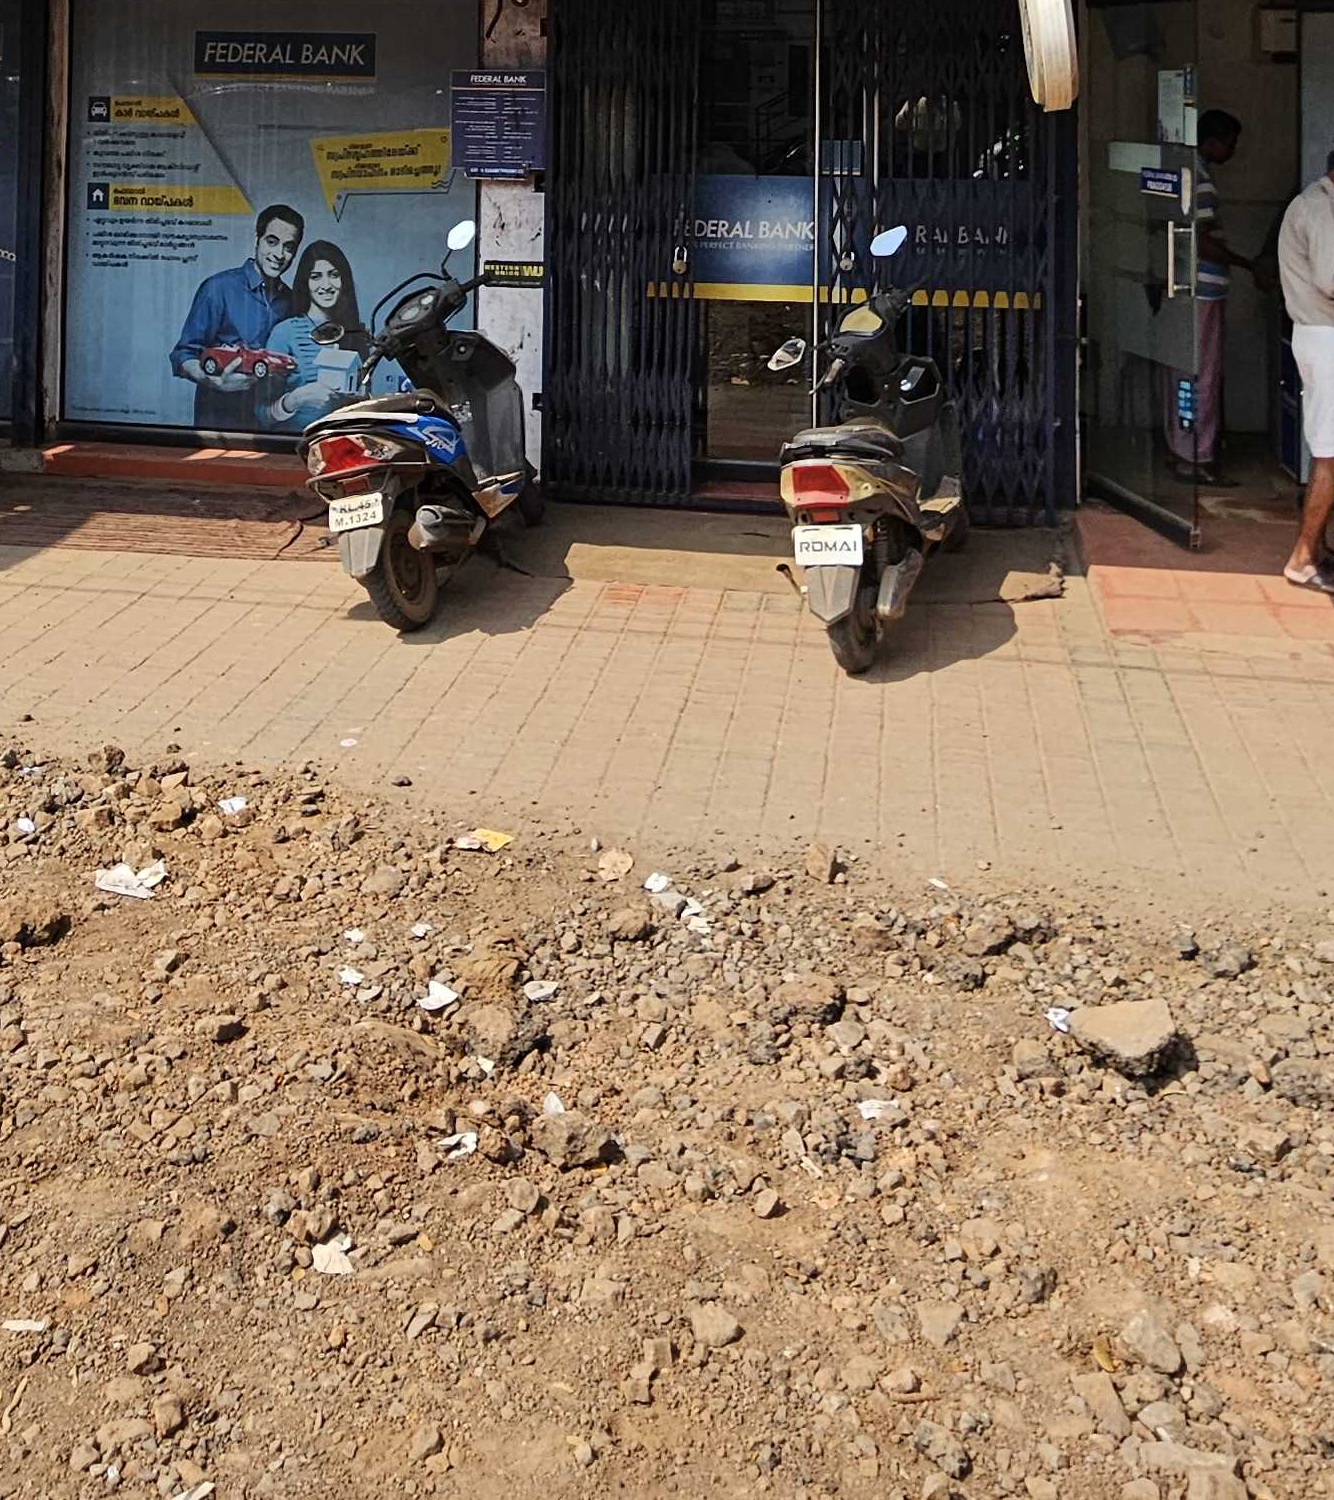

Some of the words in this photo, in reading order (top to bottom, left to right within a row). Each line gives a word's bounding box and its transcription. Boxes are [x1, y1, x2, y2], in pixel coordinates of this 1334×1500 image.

[203, 41, 296, 65] FEDERAL
[299, 43, 366, 66] BANK
[470, 74, 502, 83] FEDERAL
[503, 75, 527, 84] BANK
[758, 220, 814, 240] BANK
